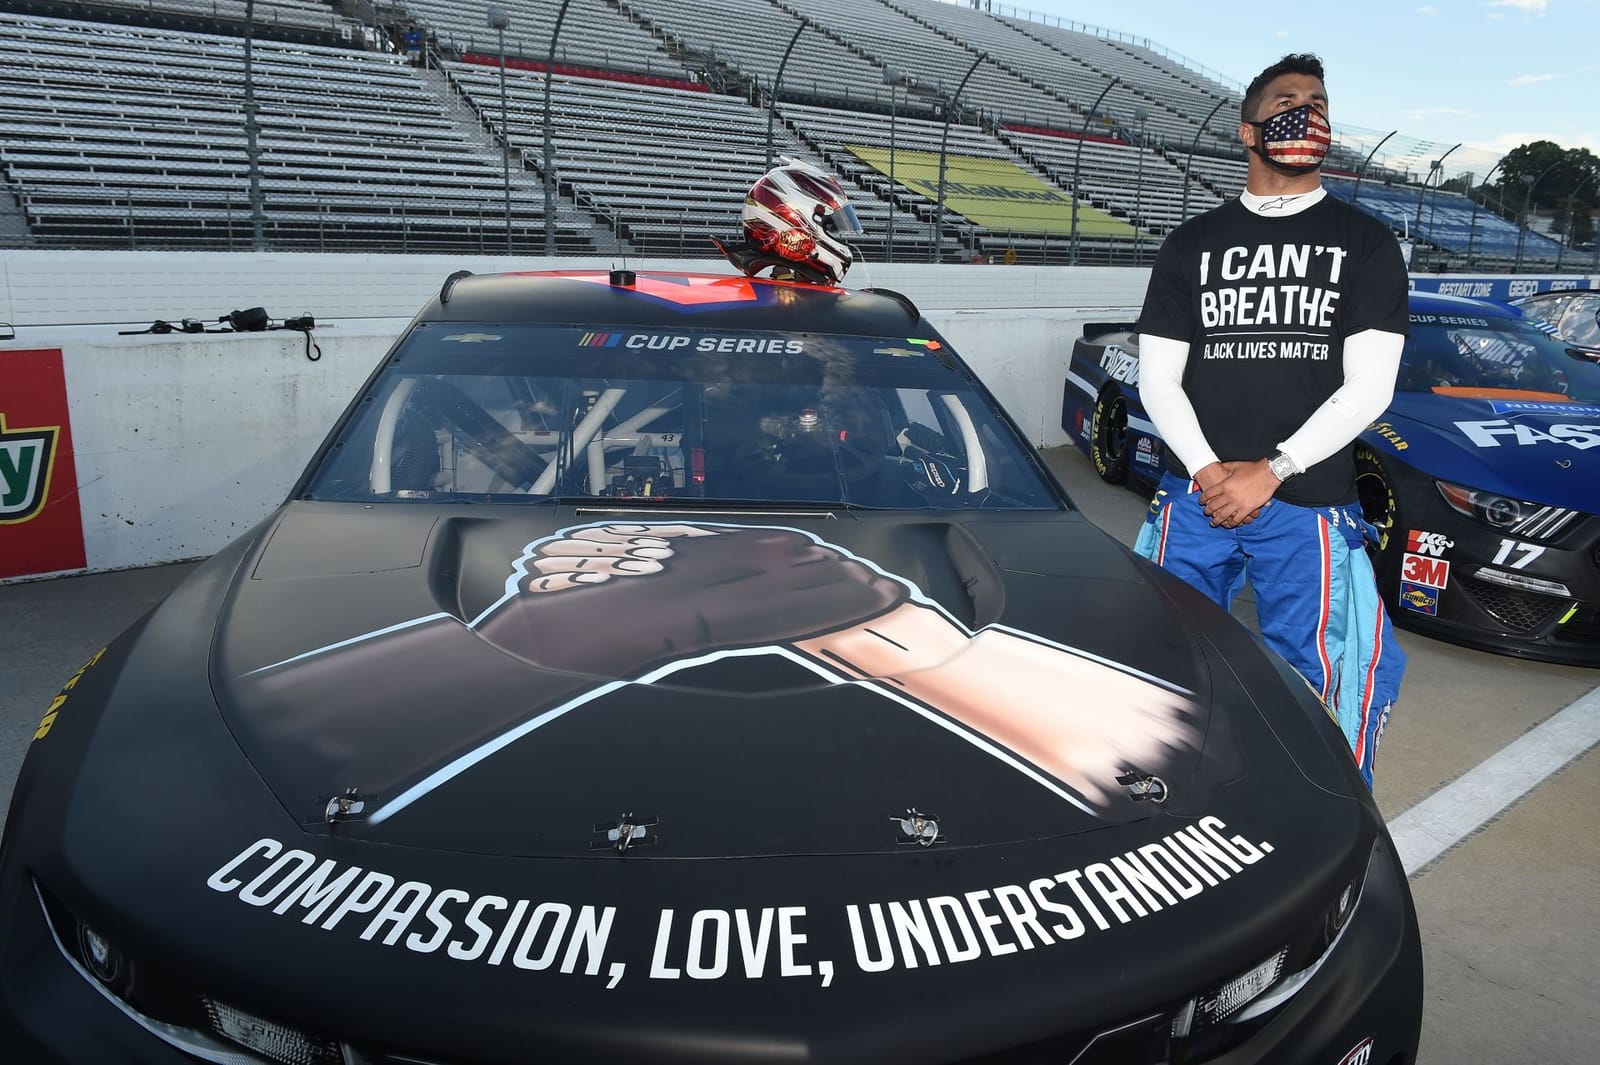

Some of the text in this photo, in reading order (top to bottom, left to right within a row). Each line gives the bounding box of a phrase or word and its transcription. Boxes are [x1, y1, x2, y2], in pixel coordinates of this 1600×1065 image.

[1200, 251, 1211, 286] I
[1438, 282, 1494, 297] RESTART ZONE
[1509, 280, 1538, 297] GEICO
[1201, 285, 1340, 328] BREATHE
[1409, 314, 1489, 327] CUP SERIES
[625, 334, 804, 354] CUP SERIES
[1237, 342, 1277, 359] LIVES
[661, 433, 674, 442] 43
[1452, 419, 1600, 450] FAS
[1491, 538, 1547, 569] 17
[1403, 556, 1448, 588] 3M
[1403, 592, 1435, 606] SUNOCO
[206, 815, 1275, 989] COMPASSION, LOVE, UNDERSTANDING.
